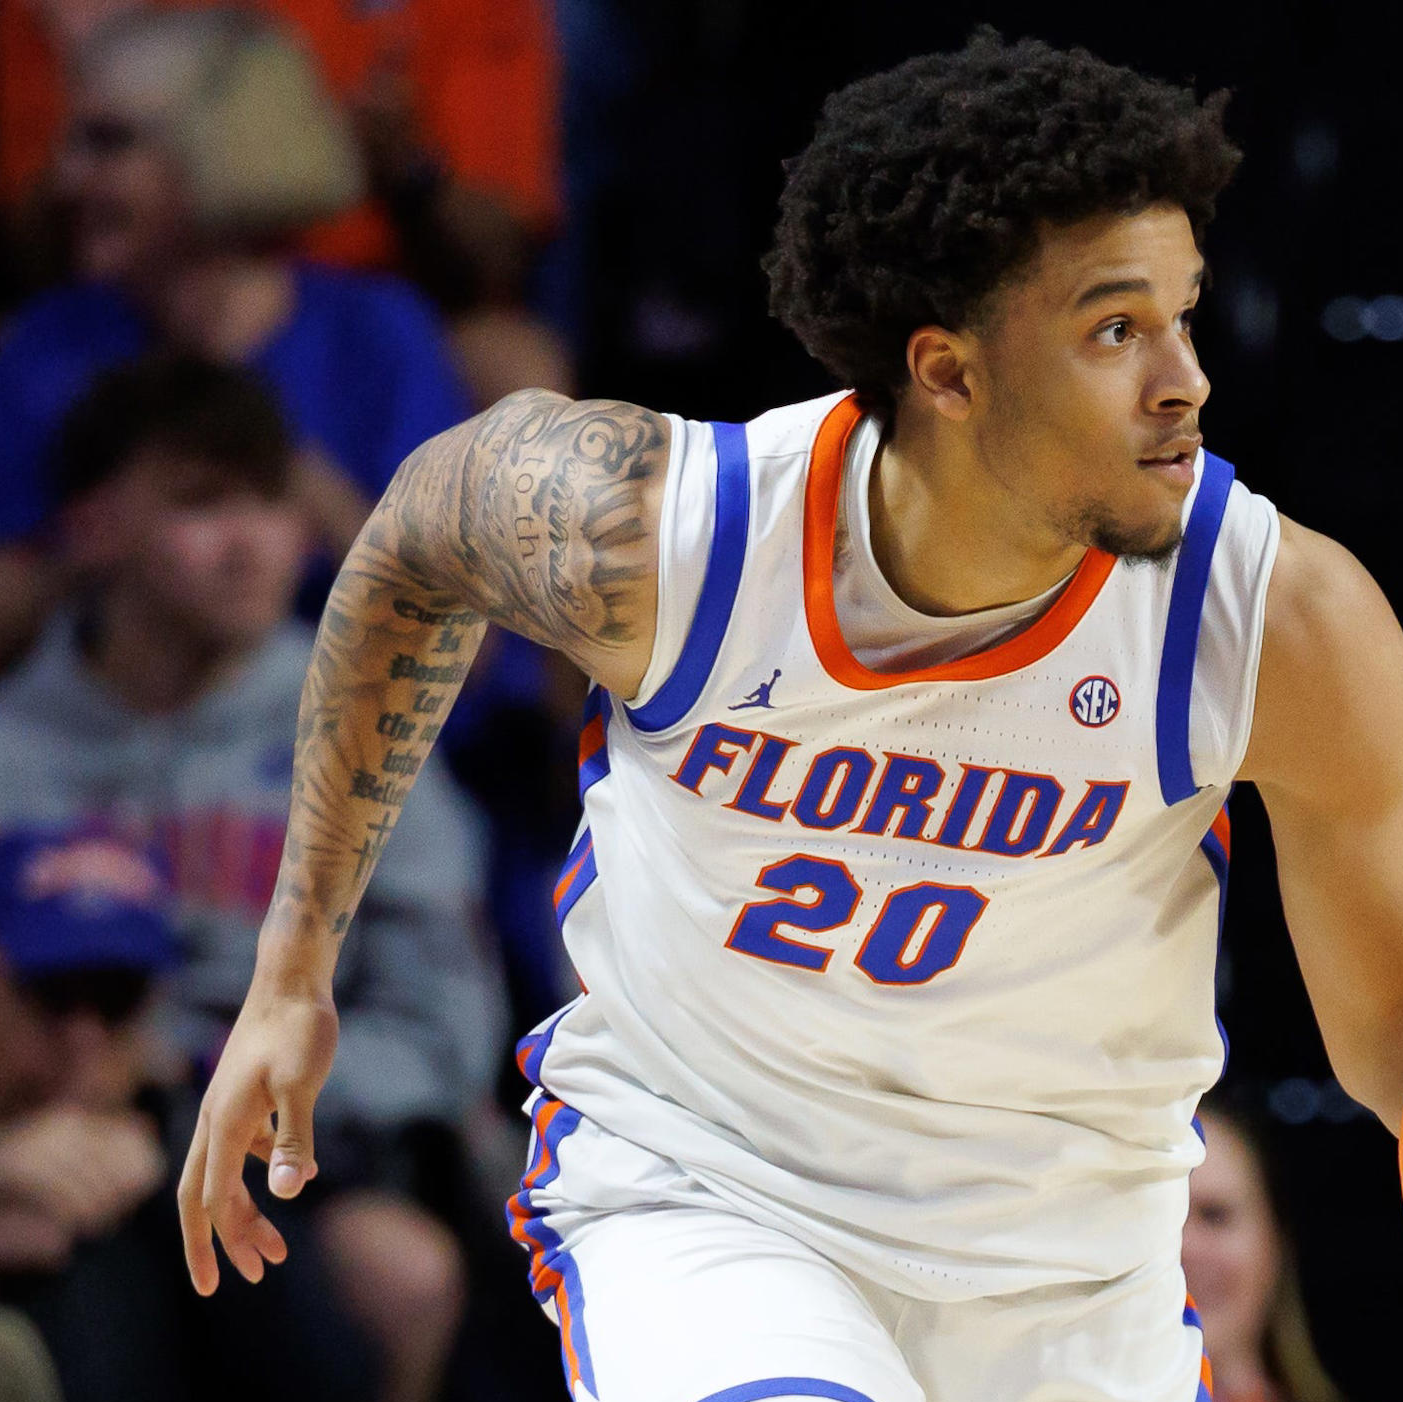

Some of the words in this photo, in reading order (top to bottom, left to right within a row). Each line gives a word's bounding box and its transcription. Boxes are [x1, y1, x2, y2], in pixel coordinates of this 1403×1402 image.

[1075, 679, 1118, 724] SEC
[668, 722, 1131, 859] FLORIDA
[725, 853, 990, 987] 20
